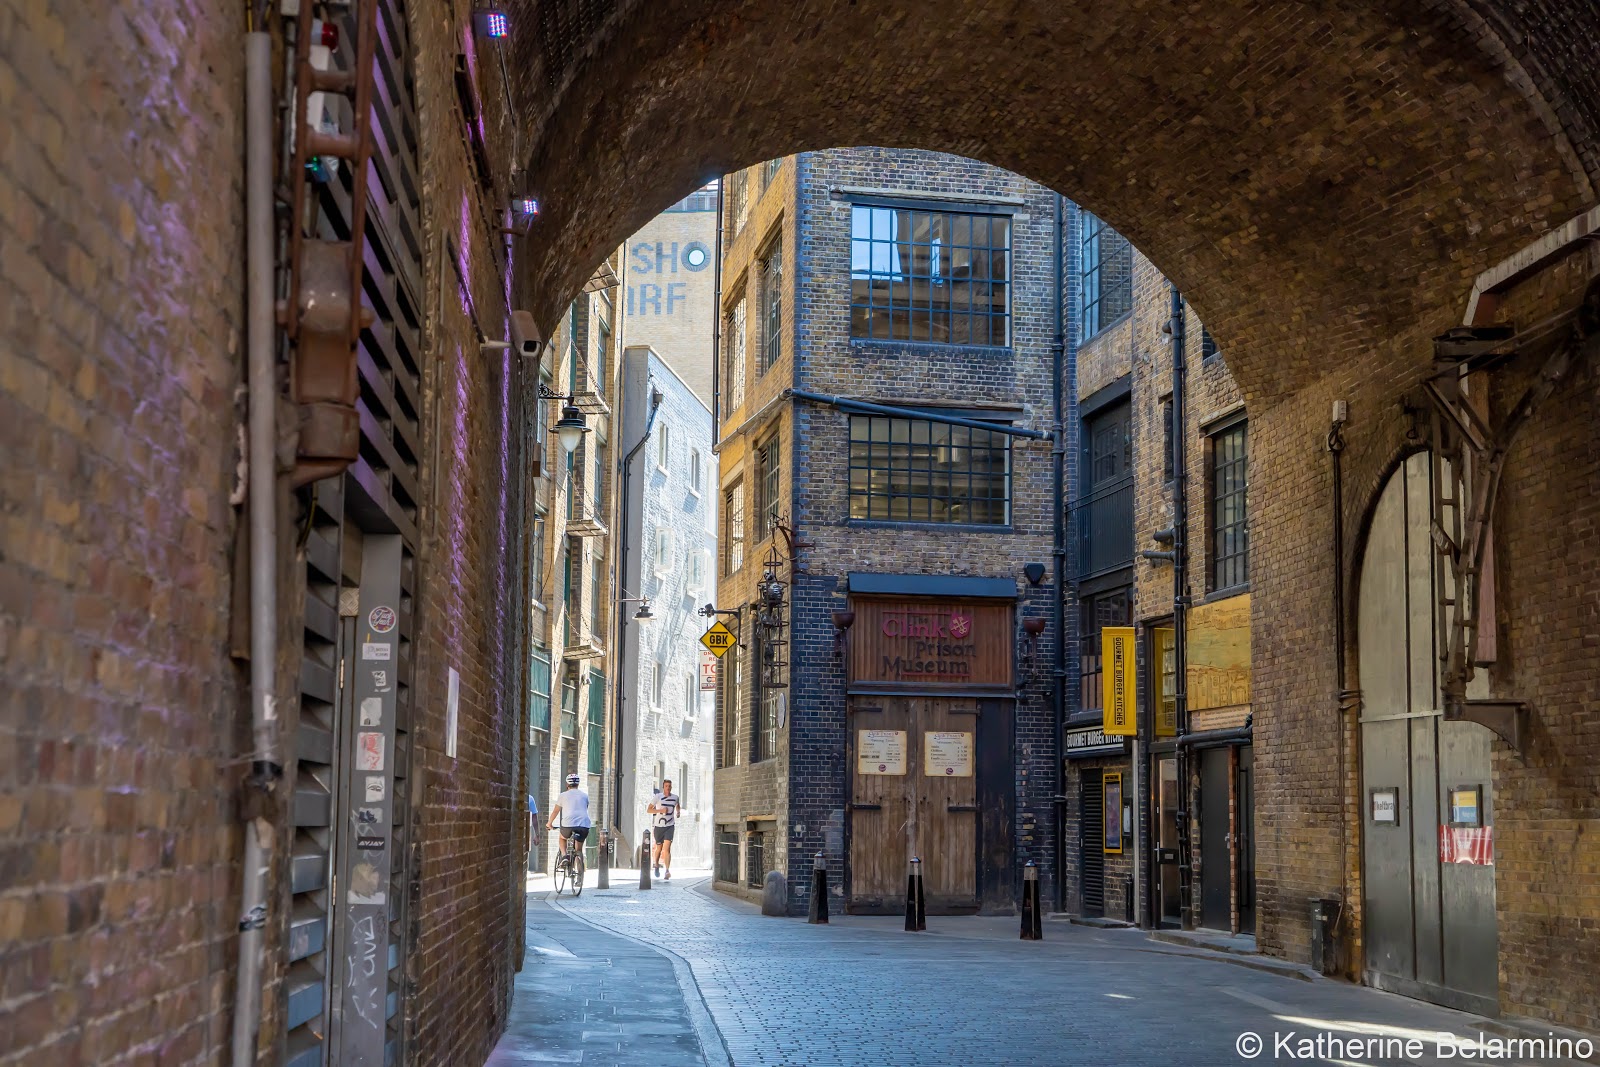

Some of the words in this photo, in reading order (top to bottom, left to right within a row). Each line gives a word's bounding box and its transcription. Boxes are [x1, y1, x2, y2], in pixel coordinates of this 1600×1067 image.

[882, 618, 947, 638] Clink
[912, 615, 928, 624] The
[709, 634, 728, 645] GBK
[916, 641, 976, 658] Prison
[881, 655, 970, 677] Museum
[1067, 732, 1087, 748] GOURMET
[1087, 730, 1105, 746] BURGER
